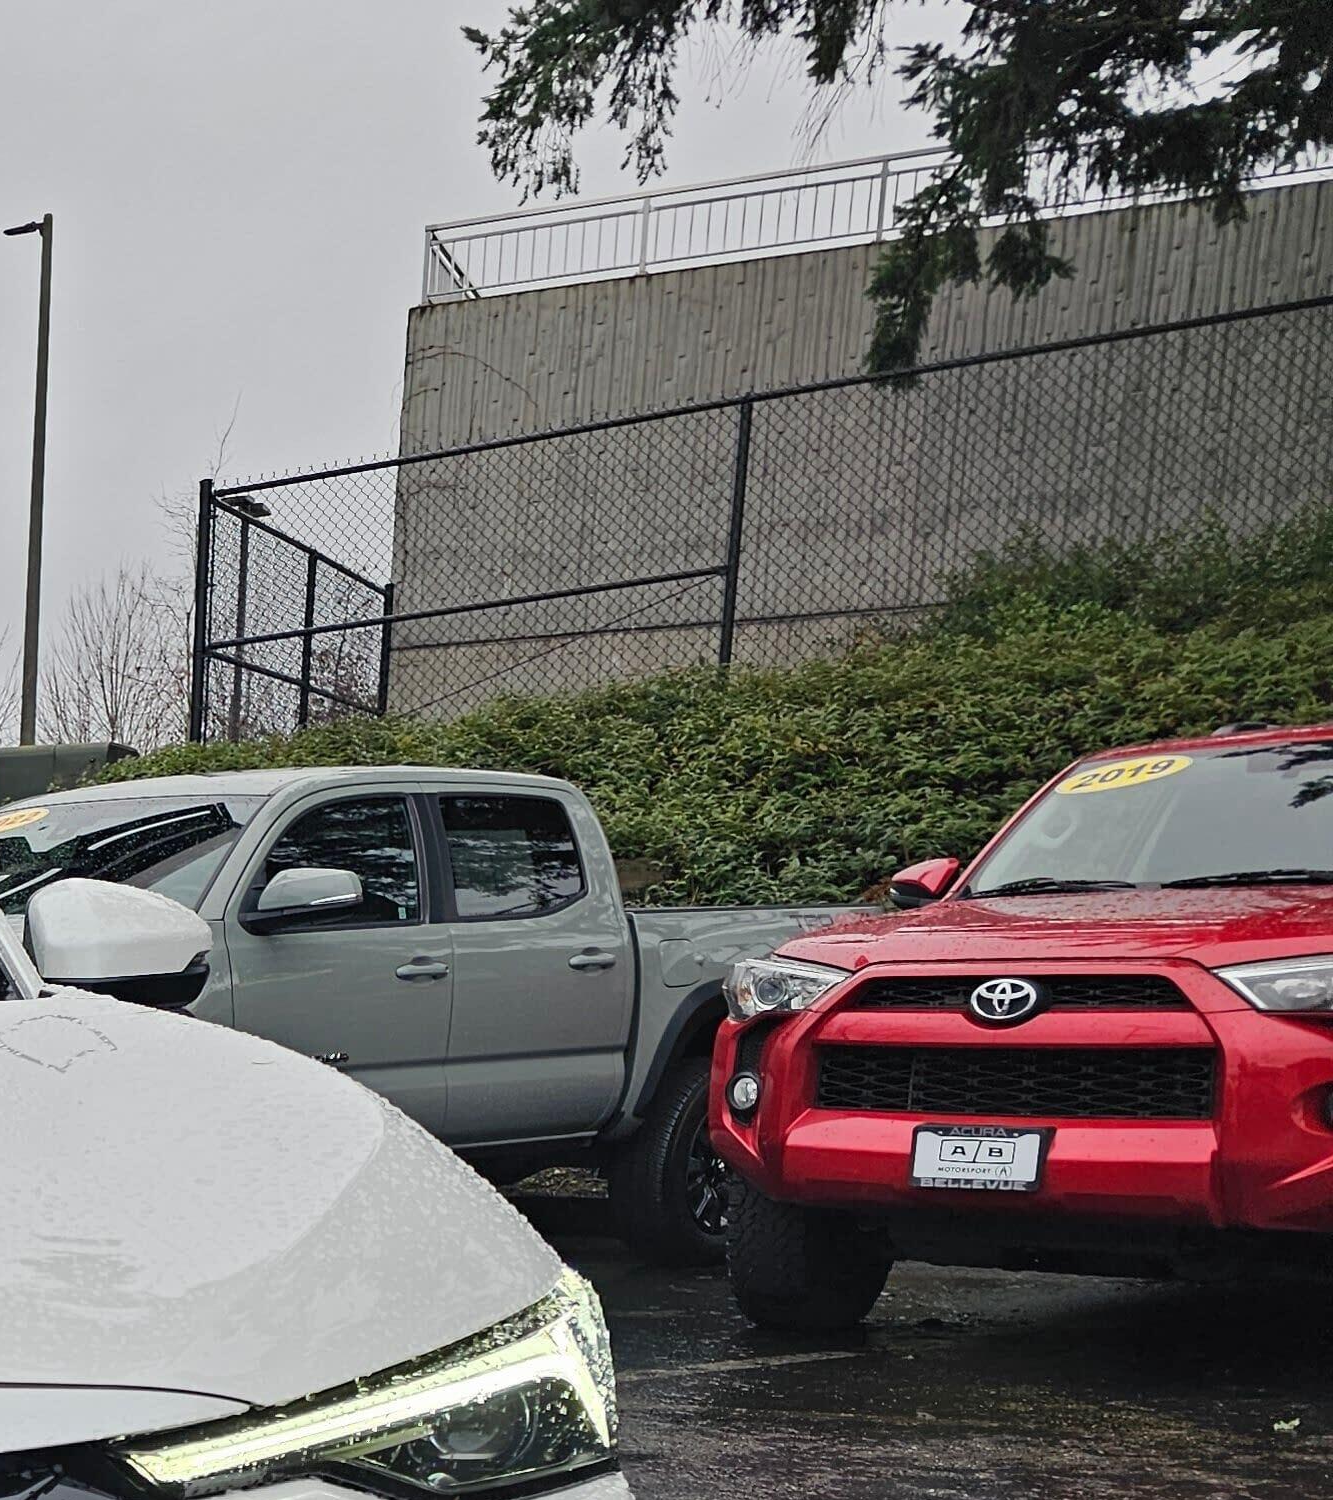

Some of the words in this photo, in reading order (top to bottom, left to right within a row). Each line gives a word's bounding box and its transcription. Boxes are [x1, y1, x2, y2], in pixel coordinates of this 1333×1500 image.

[1070, 760, 1175, 791] 2019
[949, 1127, 1007, 1137] ACURA
[938, 1166, 991, 1174] MOTORSPORT
[920, 1177, 1027, 1191] BELLEVUE
